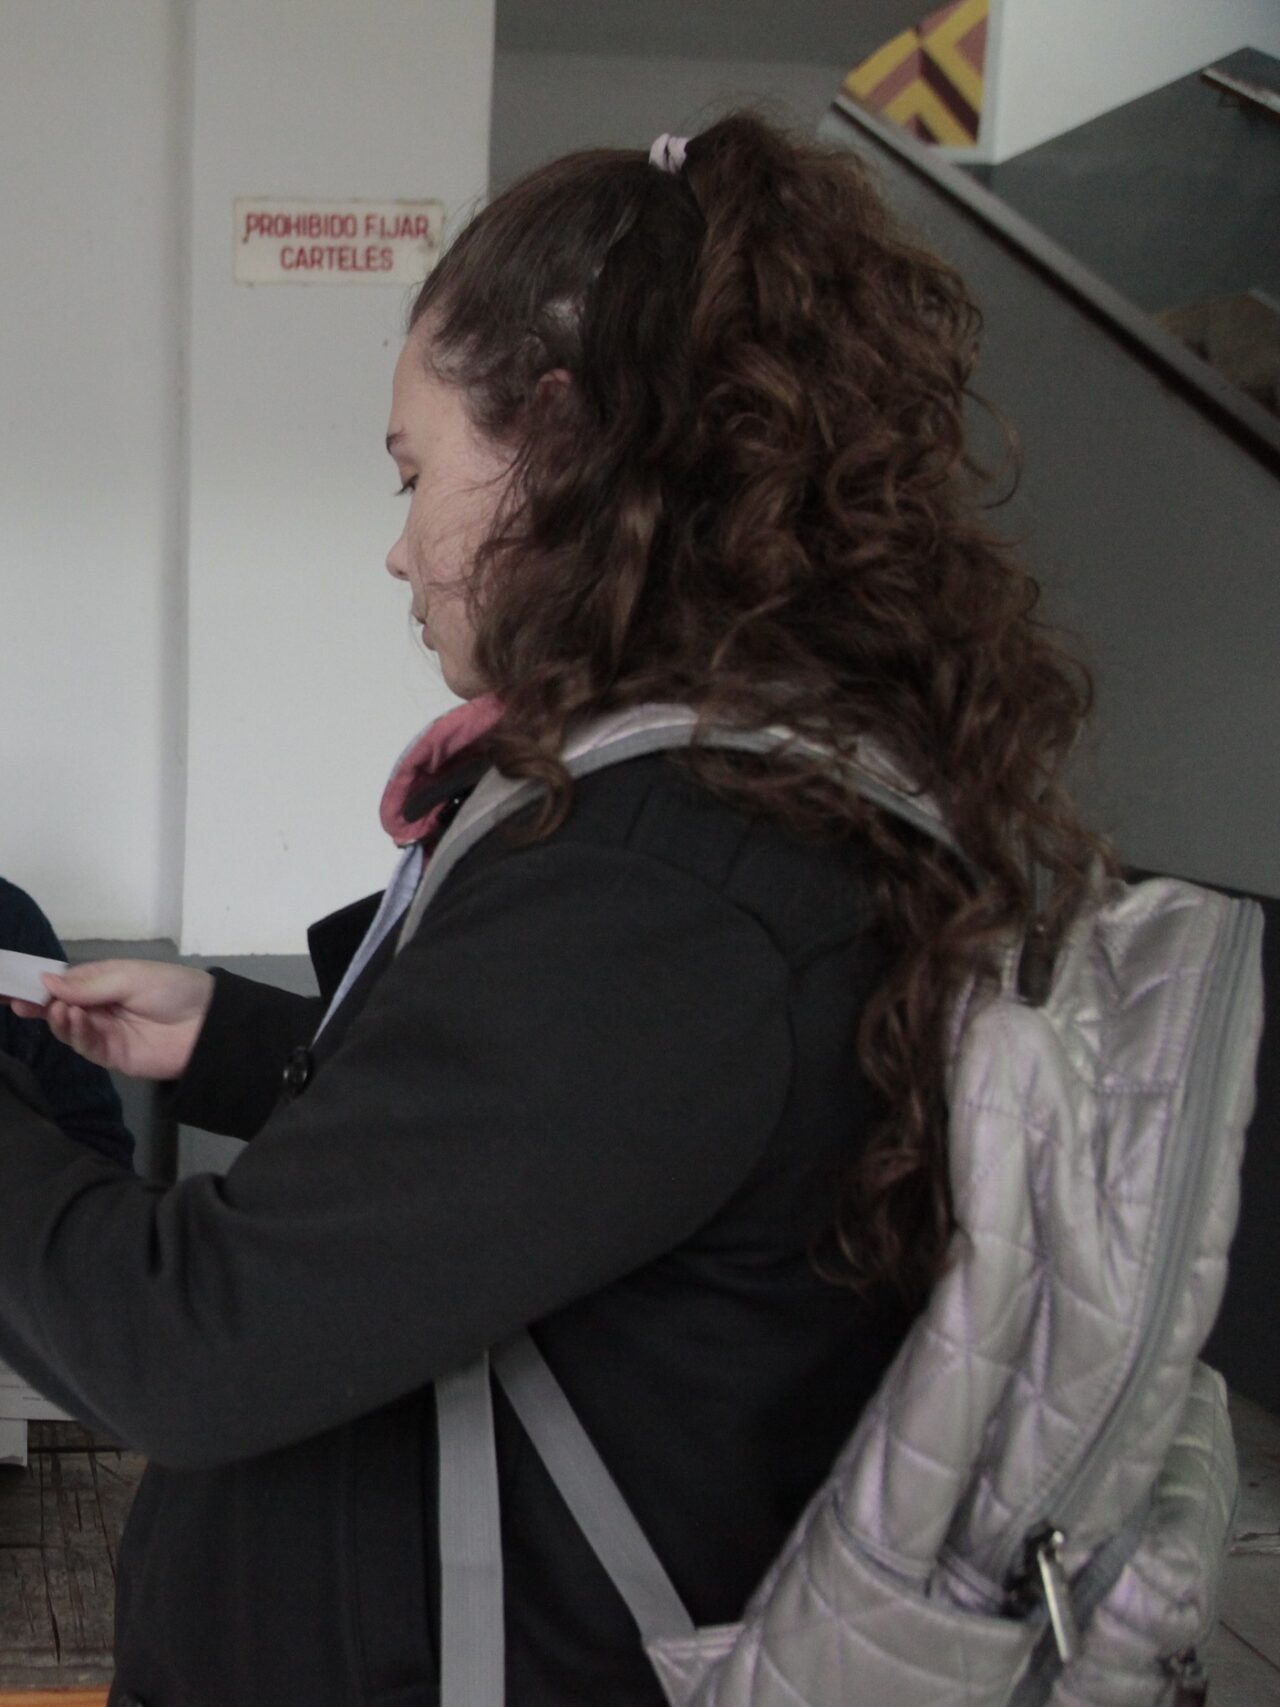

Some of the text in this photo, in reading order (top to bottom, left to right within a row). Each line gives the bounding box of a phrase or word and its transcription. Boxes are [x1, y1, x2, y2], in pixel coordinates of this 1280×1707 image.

[245, 212, 430, 239] PROHIBIDO FIJAR
[279, 245, 394, 272] CARTELES
